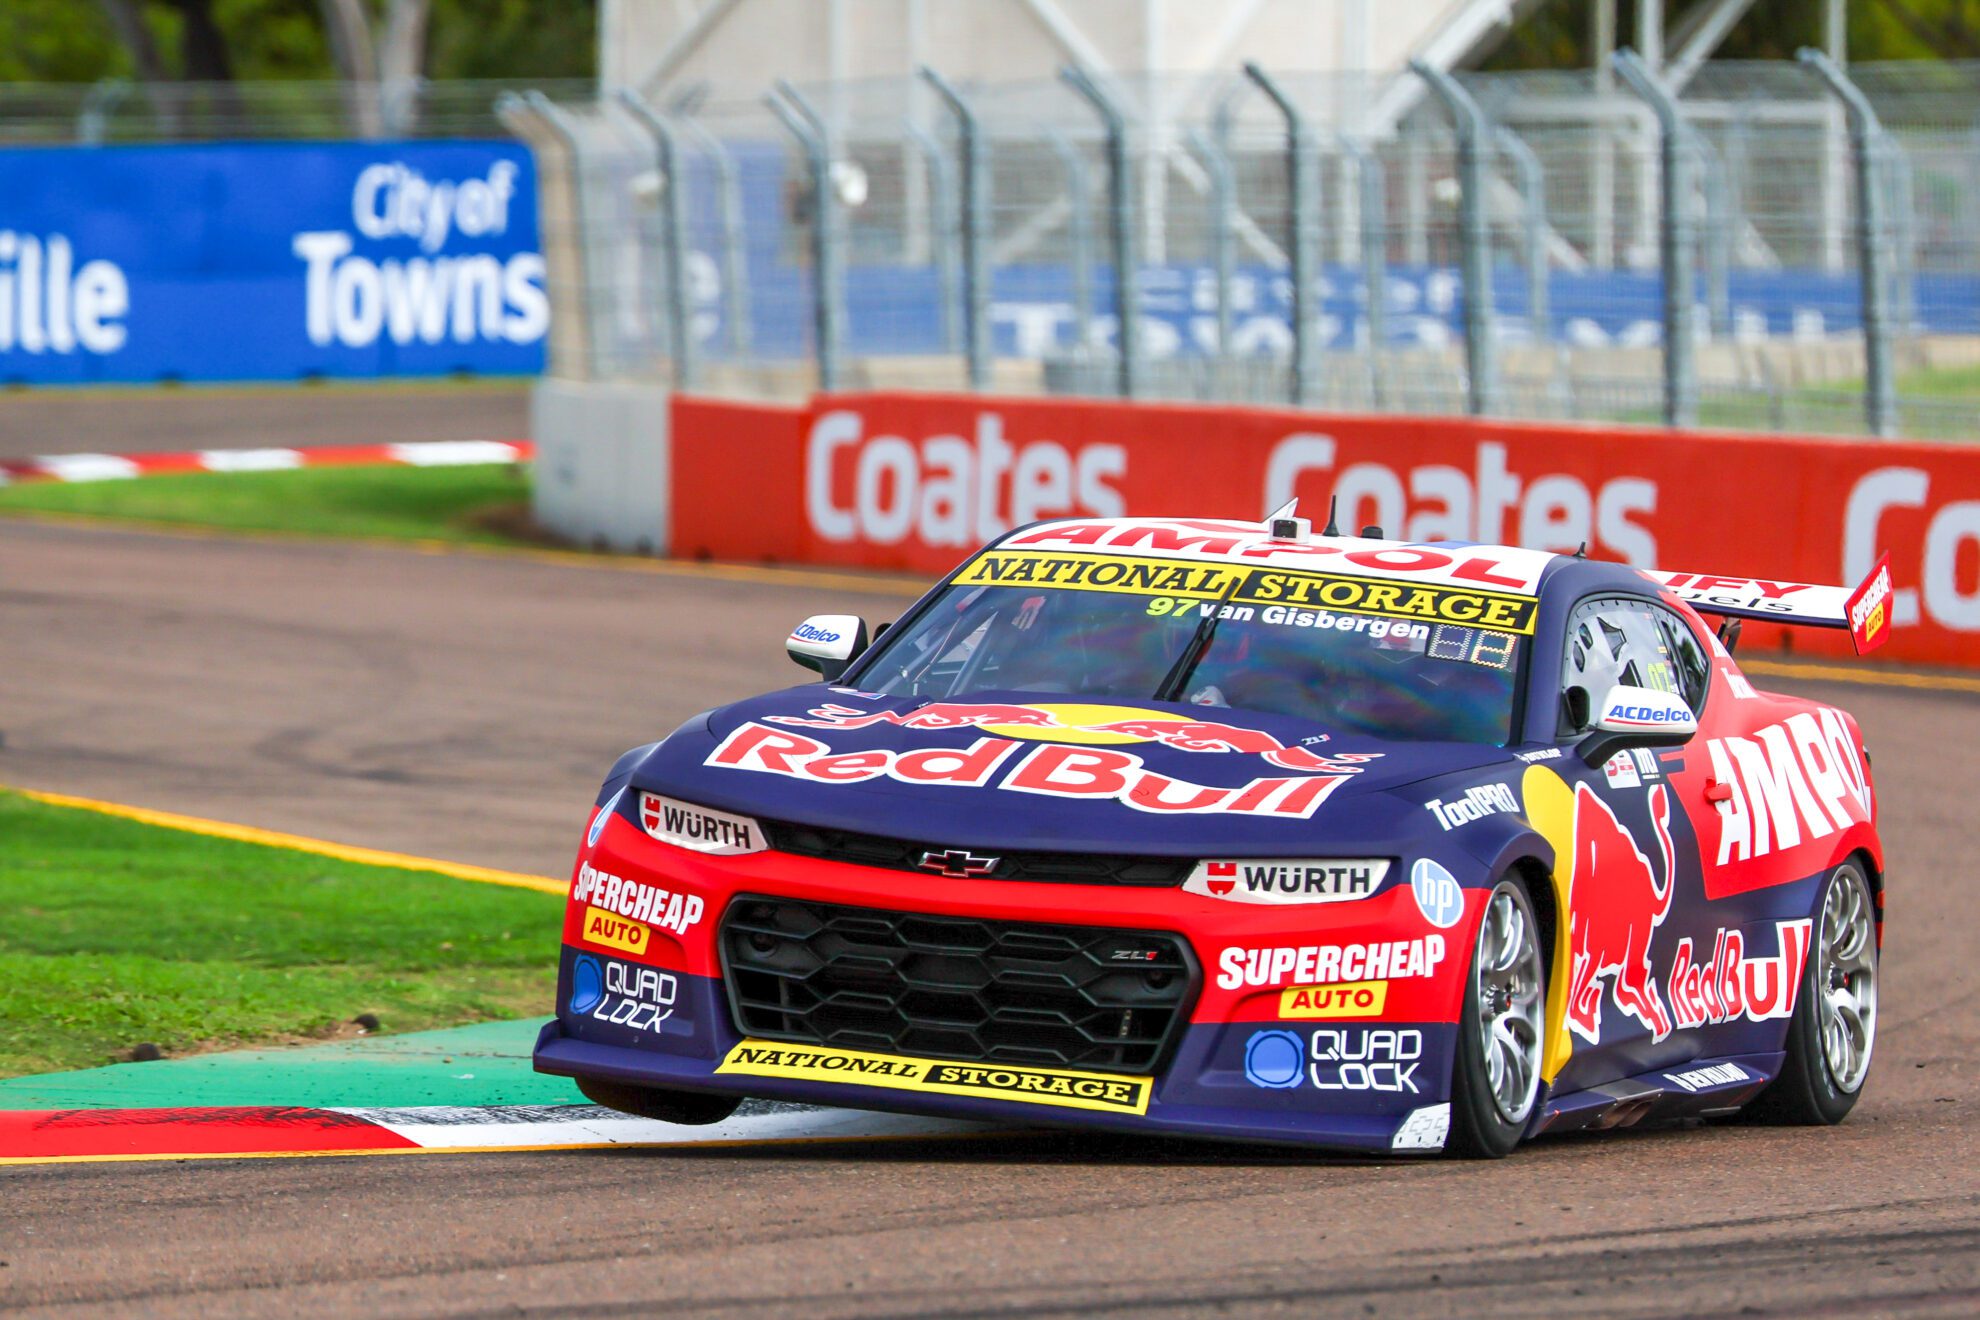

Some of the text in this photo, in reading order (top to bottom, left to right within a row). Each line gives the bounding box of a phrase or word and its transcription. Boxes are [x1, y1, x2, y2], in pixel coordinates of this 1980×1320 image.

[353, 158, 518, 253] City of
[806, 410, 1127, 548] Coates
[1264, 432, 1658, 570] Coates
[1010, 524, 1528, 588] AMPOL
[970, 557, 1523, 627] NATIONAL STORAGE
[1145, 597, 1430, 639] 97 van Gisbergen
[794, 623, 841, 643] CDelco
[1608, 705, 1691, 722] ACDelco
[702, 721, 1355, 820] Red Bull
[574, 861, 704, 935] SUPERCHEAP
[1421, 861, 1452, 925] hp
[590, 916, 641, 945] AUTO
[606, 961, 677, 1006] QUAD
[1217, 934, 1445, 990] SUPERCHEAP
[1668, 918, 1813, 1029] Red Bull
[593, 994, 674, 1034] LOCK
[1290, 989, 1375, 1010] AUTO
[1311, 1029, 1422, 1061] QUAD
[731, 1048, 1131, 1102] NATIONAL STORAGE
[1310, 1063, 1420, 1094] LOCK
